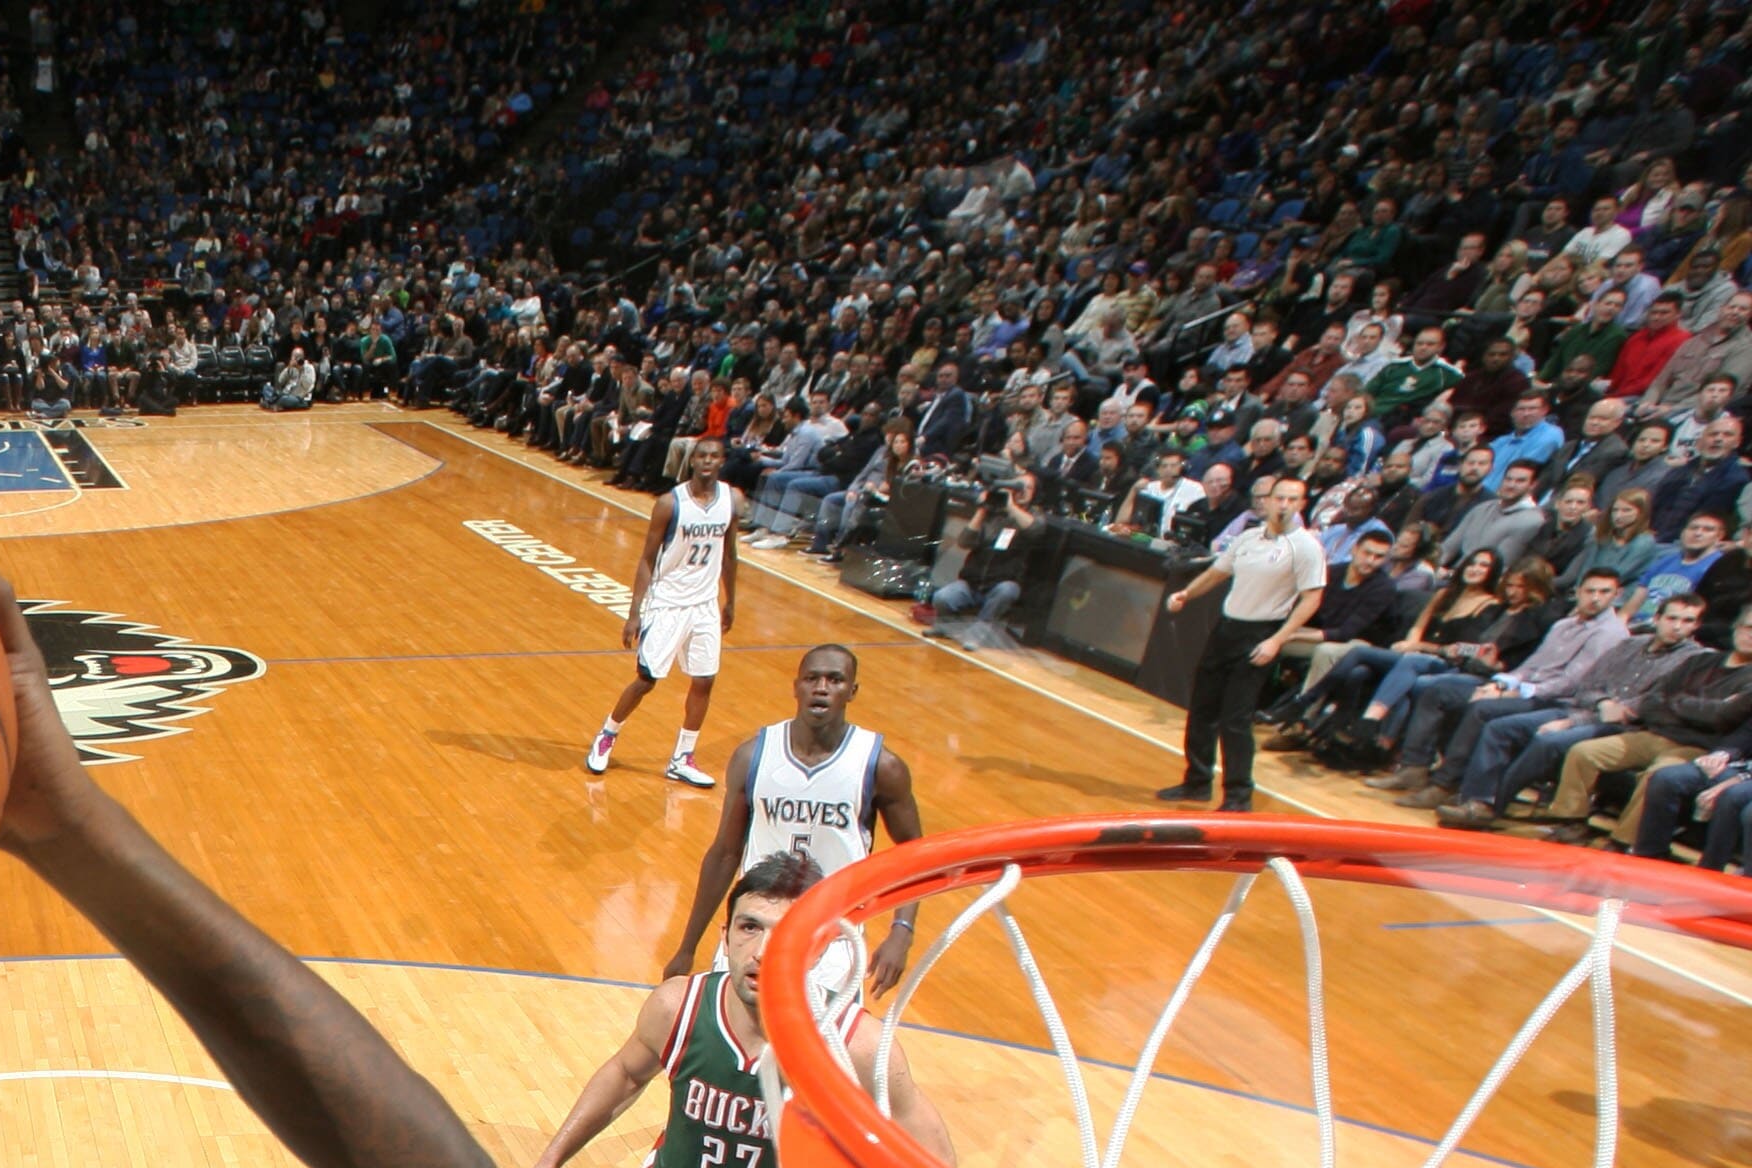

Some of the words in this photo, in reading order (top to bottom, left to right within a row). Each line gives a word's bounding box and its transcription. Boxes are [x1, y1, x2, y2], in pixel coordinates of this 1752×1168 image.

[462, 519, 576, 566] CENTER
[682, 523, 726, 540] WOLVES
[688, 544, 711, 566] 22
[538, 567, 646, 620] ARGET
[760, 796, 852, 829] WOLVES
[790, 833, 811, 863] 5
[684, 1078, 774, 1139] BUCK
